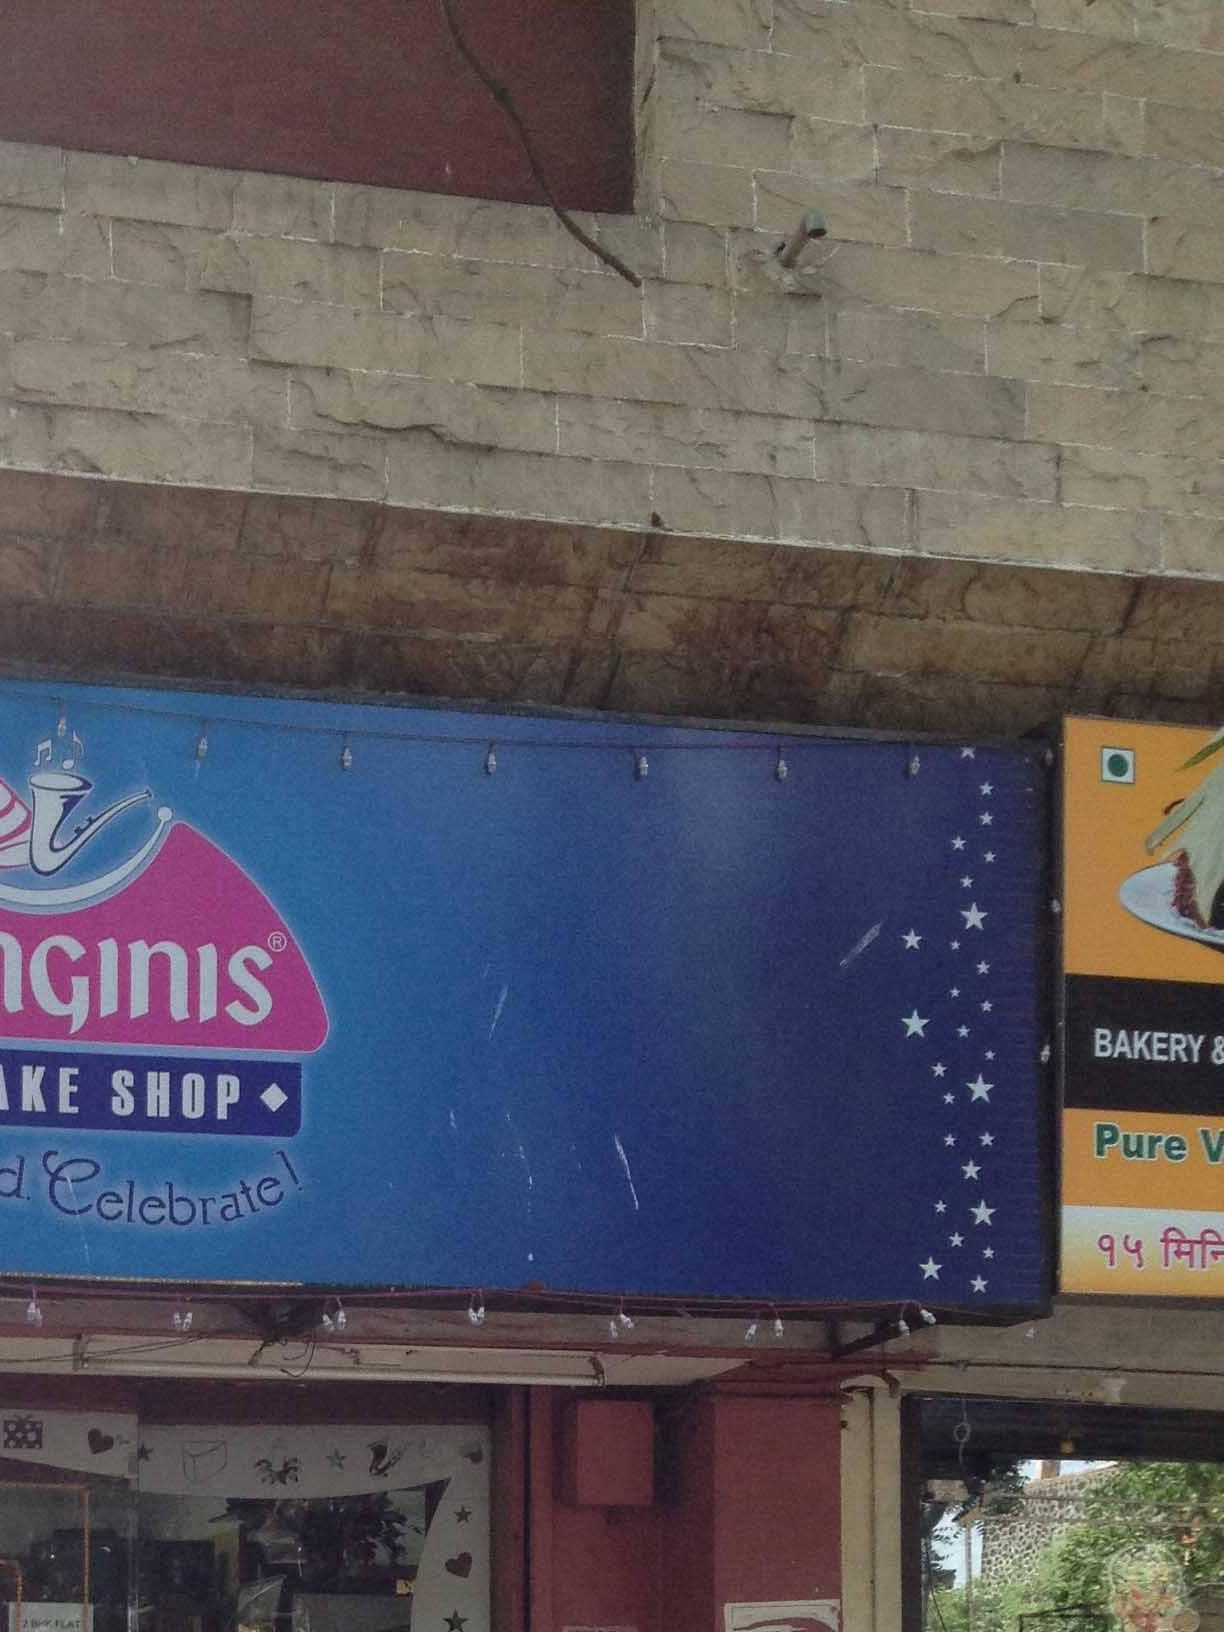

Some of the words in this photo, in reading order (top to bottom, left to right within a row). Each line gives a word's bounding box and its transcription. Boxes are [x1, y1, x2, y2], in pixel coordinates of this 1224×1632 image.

[1094, 1028, 1205, 1064] BAKERY
[1211, 1036, 1224, 1064] &
[112, 1069, 240, 1120] SHOP
[1094, 1122, 1189, 1164] Pure
[43, 1150, 303, 1226] Celebrate!
